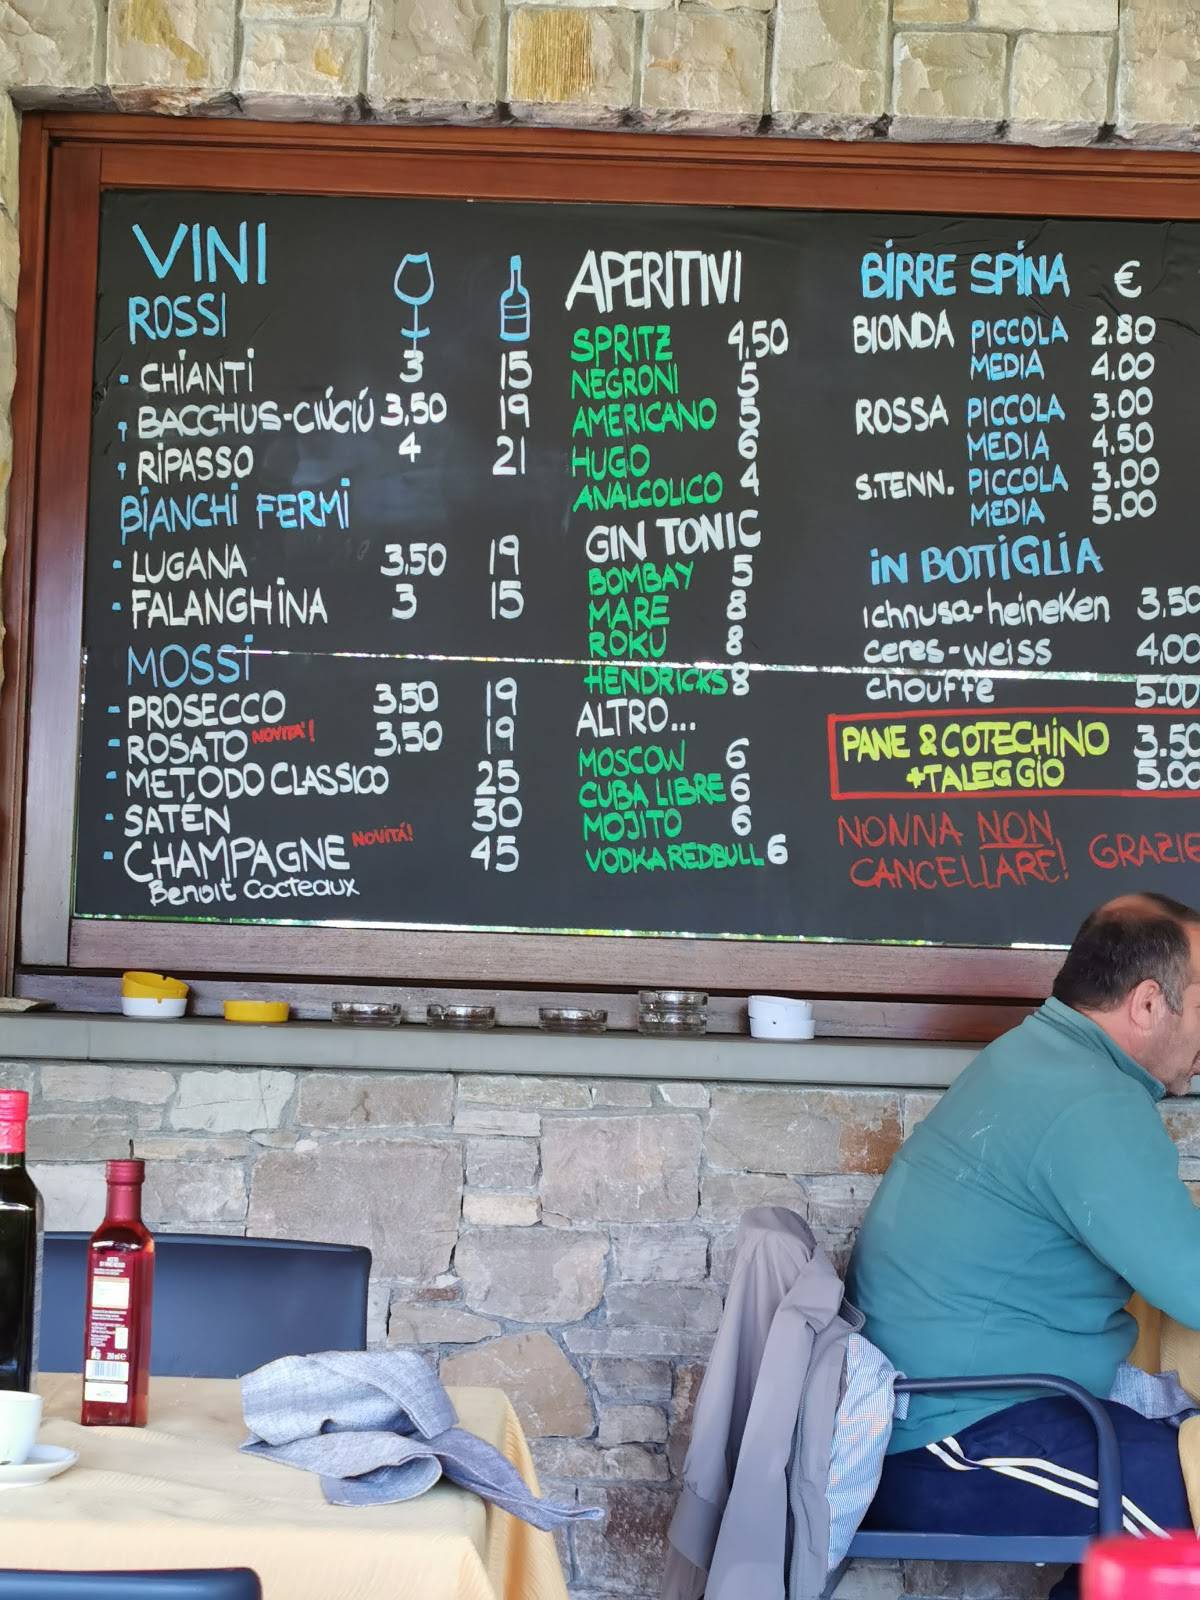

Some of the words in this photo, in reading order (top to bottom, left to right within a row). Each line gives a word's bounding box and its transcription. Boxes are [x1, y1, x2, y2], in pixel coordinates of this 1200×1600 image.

[132, 222, 268, 285] VINI
[565, 249, 741, 313] APERITIVI
[1114, 260, 1142, 298] €
[128, 292, 226, 344] ROSSI
[853, 308, 955, 354] BIONDA
[971, 315, 1069, 353] PICCOLA
[571, 324, 672, 367] SPRITZ
[970, 349, 1044, 380] MEDIA
[399, 349, 425, 383] 3
[500, 350, 533, 392] 15
[571, 363, 679, 400] NEGRONI
[737, 361, 760, 398] 5
[499, 396, 530, 429] 19
[572, 397, 717, 438] AMERICANO
[738, 396, 761, 430] 5
[855, 394, 949, 435] ROSSA
[967, 393, 1065, 427] PICCOLA
[399, 433, 421, 462] 4
[492, 436, 526, 475] 21
[572, 444, 650, 481] HUGO
[738, 428, 759, 460] 6
[966, 429, 1050, 461] MEDIA
[572, 471, 723, 512] ANALCOLICO
[740, 461, 759, 496] 4
[968, 464, 1068, 495] PICCOLA
[1091, 457, 1159, 492] 3.00
[970, 497, 1045, 527] MEDIA
[1092, 489, 1157, 525] 5.00
[586, 520, 647, 562] GIN
[656, 509, 761, 555] TONIC
[132, 543, 247, 584] LUGANA
[489, 535, 520, 576] 19
[588, 560, 694, 596] BOMBAY
[732, 554, 753, 587] 5
[392, 583, 417, 620] 3
[491, 580, 524, 620] 15
[588, 594, 670, 631] MARE
[726, 589, 747, 620] 8
[588, 628, 667, 659] ROKU
[726, 625, 744, 656] 8
[583, 665, 728, 696] HENDRICKS
[730, 661, 750, 696] 8
[866, 669, 995, 703] chouffe
[127, 690, 286, 730] PROSECCO
[485, 678, 517, 716] 19
[576, 697, 696, 738] ALTRO...
[127, 730, 248, 764] ROSATO
[485, 716, 514, 754] 19
[578, 739, 686, 777] MOSCOW
[726, 737, 750, 769] 6
[842, 724, 911, 762] PANE
[125, 763, 264, 799] METODO
[270, 762, 389, 796] CLASSICO
[475, 760, 520, 797] 25
[578, 779, 649, 810] CUBA
[656, 773, 726, 806] LIBRE
[730, 773, 750, 803] 6
[124, 792, 230, 837] SATÉN
[471, 797, 522, 831] 30
[583, 807, 682, 841] MOJITO
[731, 804, 751, 836] 6
[837, 812, 964, 849] NONNA
[977, 809, 1054, 848] NON
[124, 835, 350, 883] CHAMPAGNE
[470, 835, 519, 872] 45
[767, 834, 788, 865] 6
[850, 838, 1070, 890] CANCELLARE!
[149, 877, 237, 907] Benoit
[243, 877, 360, 899] Cocteaux
